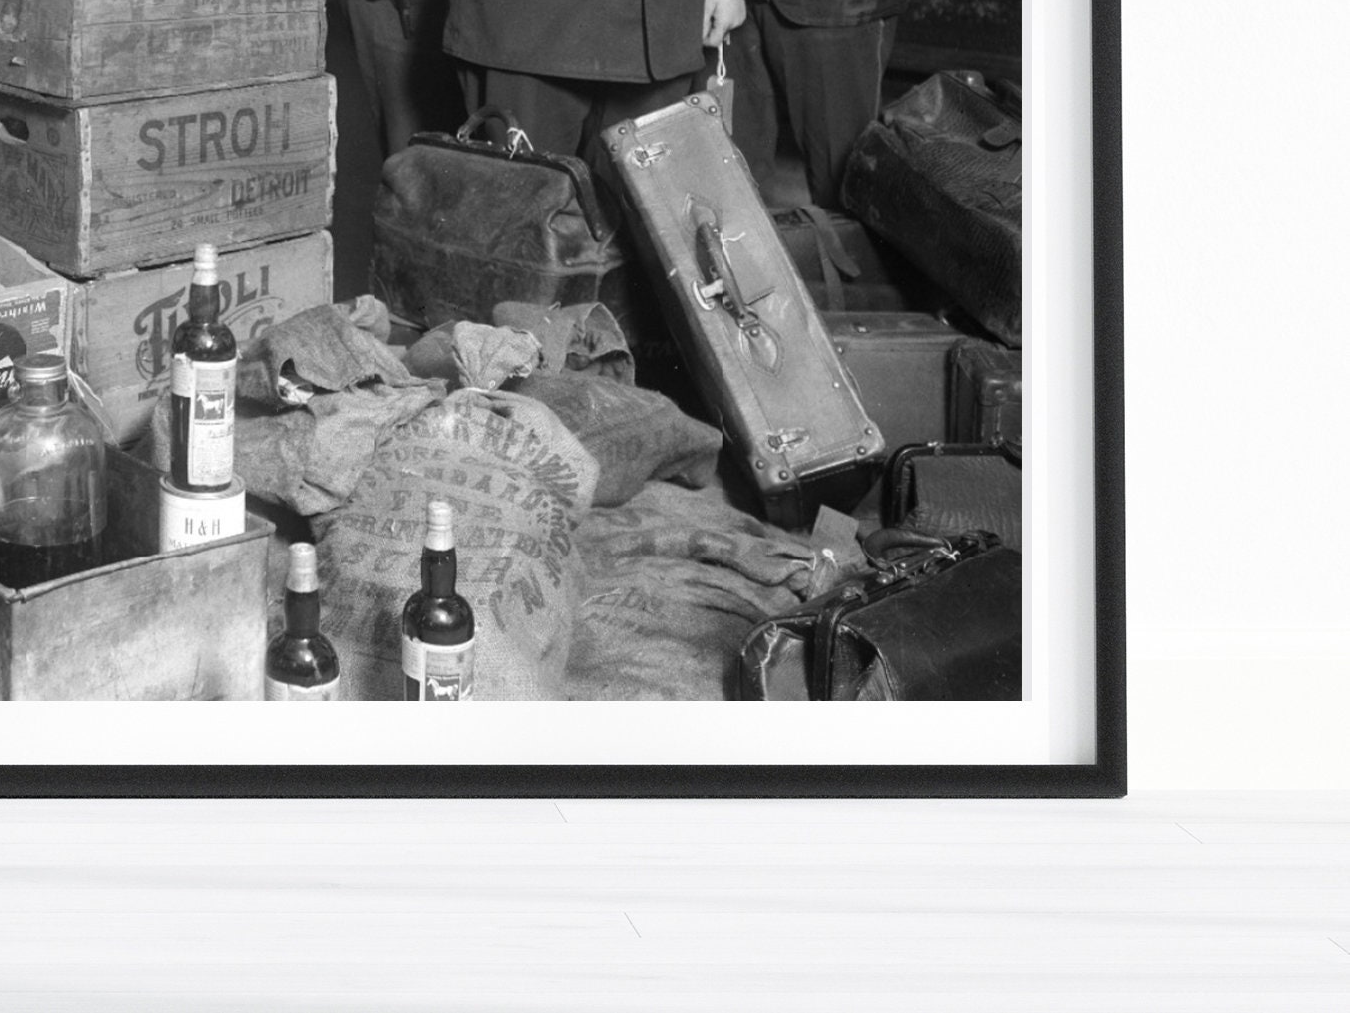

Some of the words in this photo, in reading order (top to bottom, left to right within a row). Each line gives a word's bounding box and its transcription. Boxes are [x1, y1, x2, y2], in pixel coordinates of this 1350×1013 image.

[137, 101, 291, 171] STROH
[230, 168, 312, 207] DETROIT
[134, 265, 270, 380] TIOLI
[362, 465, 547, 511] STNDARD
[184, 517, 193, 535] H
[197, 519, 208, 536] &
[211, 518, 221, 536] H
